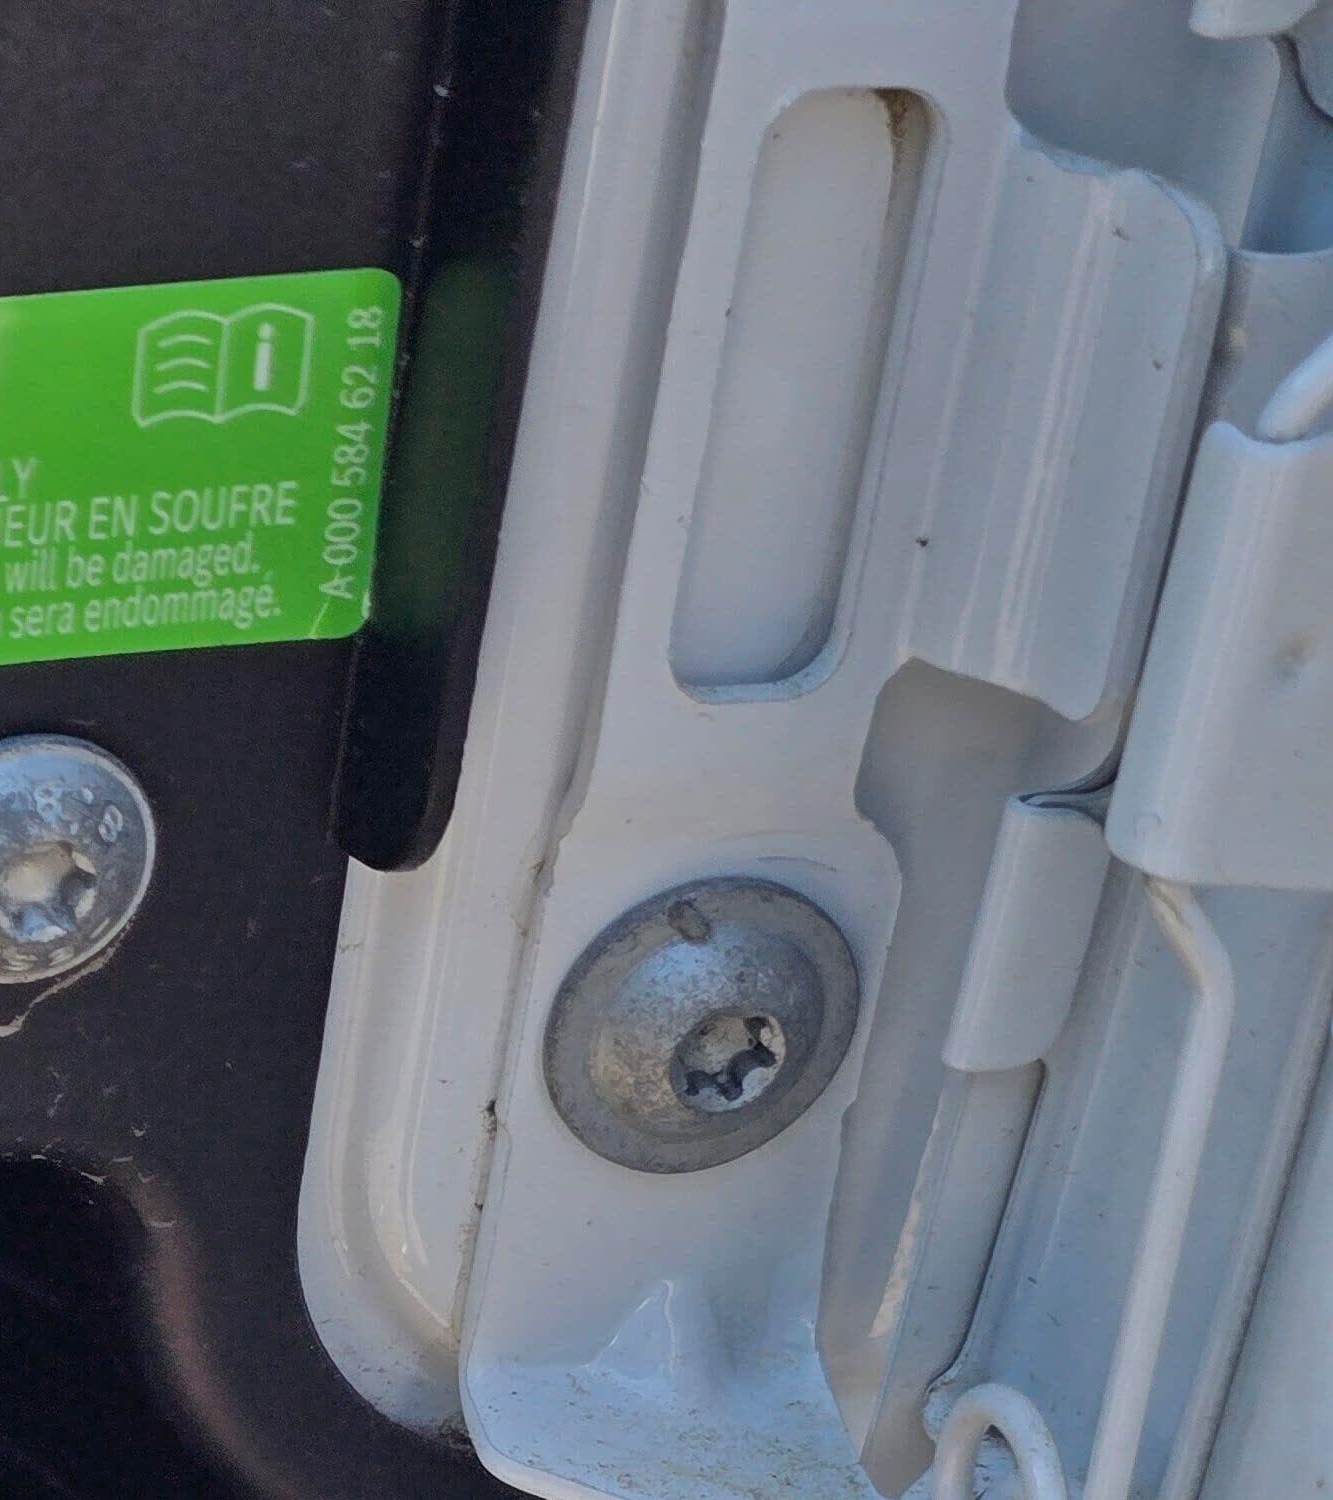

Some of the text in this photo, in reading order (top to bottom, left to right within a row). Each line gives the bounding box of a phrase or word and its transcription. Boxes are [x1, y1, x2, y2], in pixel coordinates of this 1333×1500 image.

[319, 305, 383, 600] A 000 584 62 18
[89, 495, 136, 541] EN
[148, 480, 299, 537] SOUFRE
[4, 546, 59, 594] will
[65, 544, 103, 588] be
[112, 532, 260, 589] damaged.
[9, 600, 74, 639] sera
[84, 570, 282, 632] endommagé.
